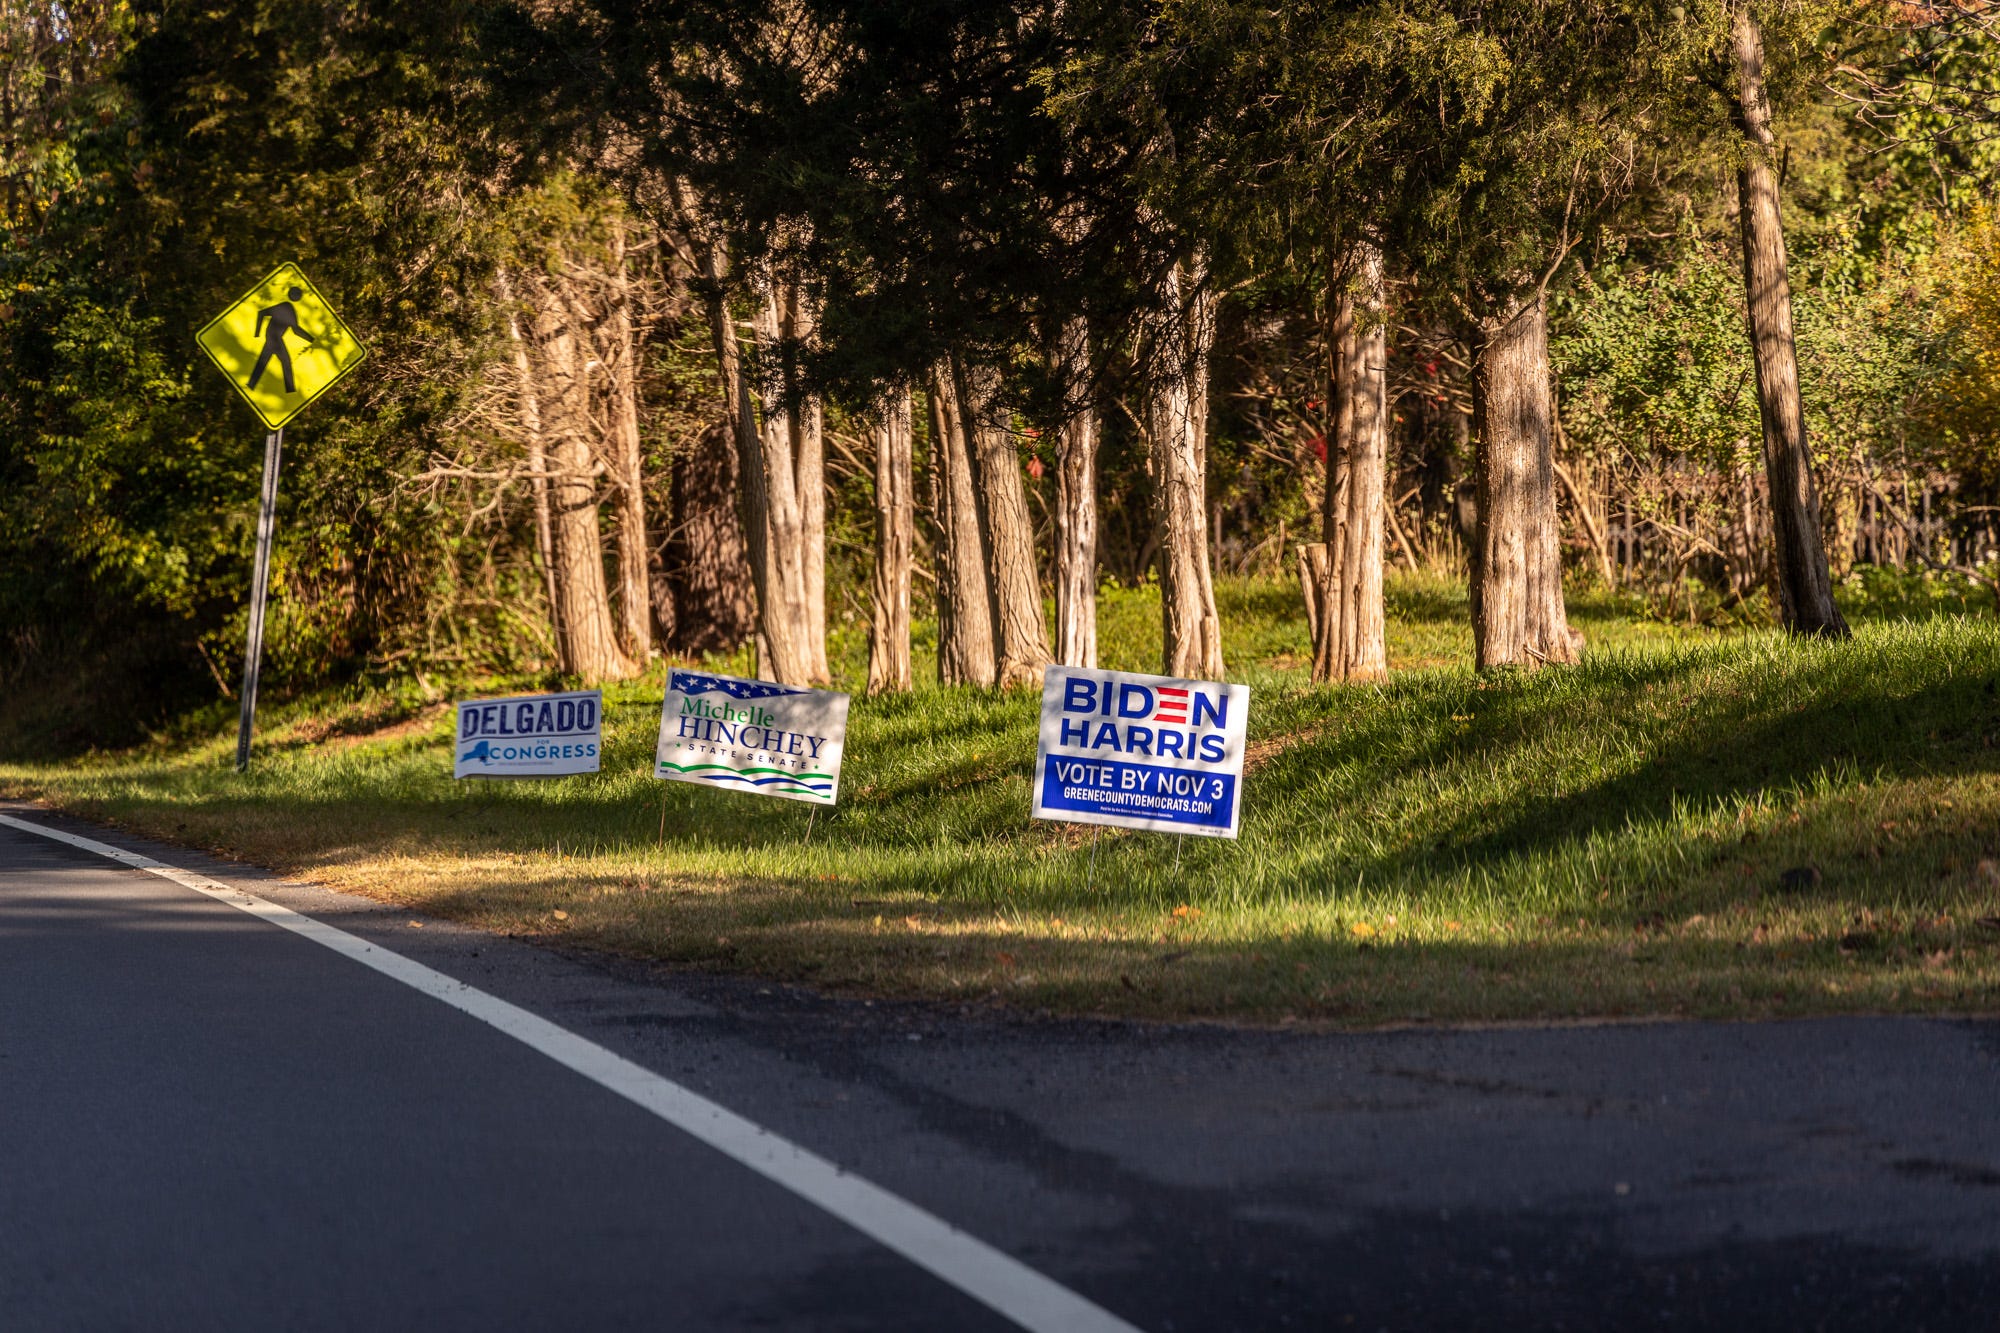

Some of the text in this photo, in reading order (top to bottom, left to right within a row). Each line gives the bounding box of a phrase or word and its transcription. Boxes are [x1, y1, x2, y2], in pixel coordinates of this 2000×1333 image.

[462, 699, 596, 738] DELGADO
[680, 696, 774, 727] Michelle
[1063, 677, 1229, 729] BIDEN
[489, 744, 596, 760] CONGRESS
[676, 716, 827, 759] HINCHEY
[688, 743, 807, 770] STATE SENATE
[1059, 718, 1225, 764] HARRIS
[1055, 761, 1224, 800] VOTE BY NOV 3
[1064, 786, 1212, 815] GREENECOUNTYDEMOCRATS.COM
